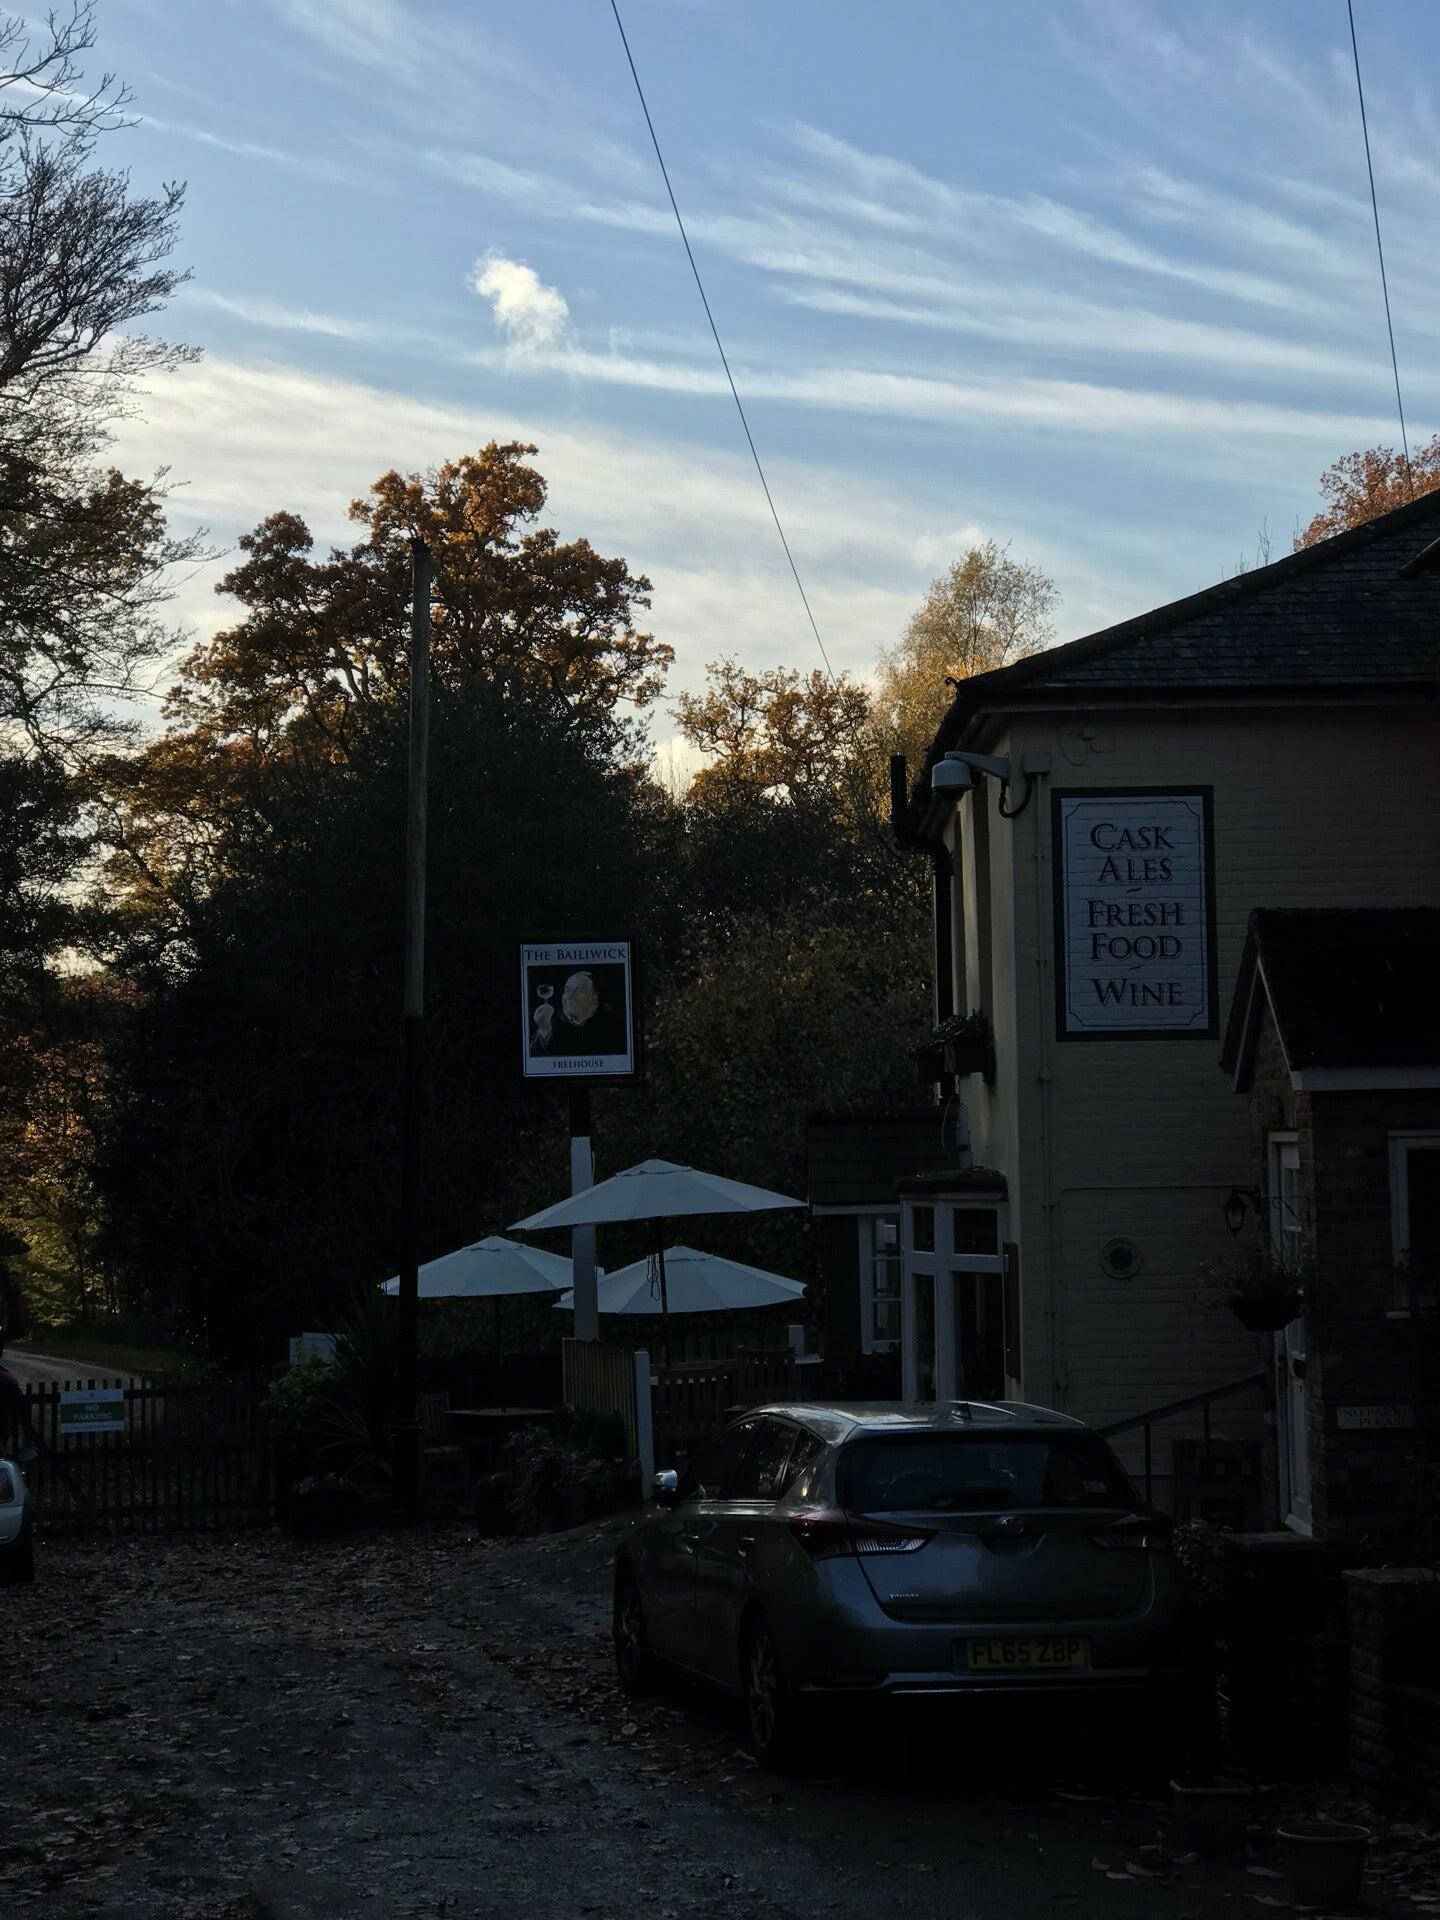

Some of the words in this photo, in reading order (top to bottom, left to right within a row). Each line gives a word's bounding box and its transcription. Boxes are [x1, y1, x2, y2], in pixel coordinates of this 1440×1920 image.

[1091, 823, 1174, 850] CASK
[1098, 855, 1173, 881] ALES
[1088, 900, 1184, 927] FRESH
[524, 949, 551, 961] THE
[557, 948, 626, 960] BAILIWICK
[1091, 933, 1181, 960] FOOD
[1092, 978, 1183, 1007] WINE
[553, 1059, 605, 1069] FREEHOUSE
[972, 1641, 1031, 1665] FL65
[1037, 1640, 1081, 1664] ZBP
